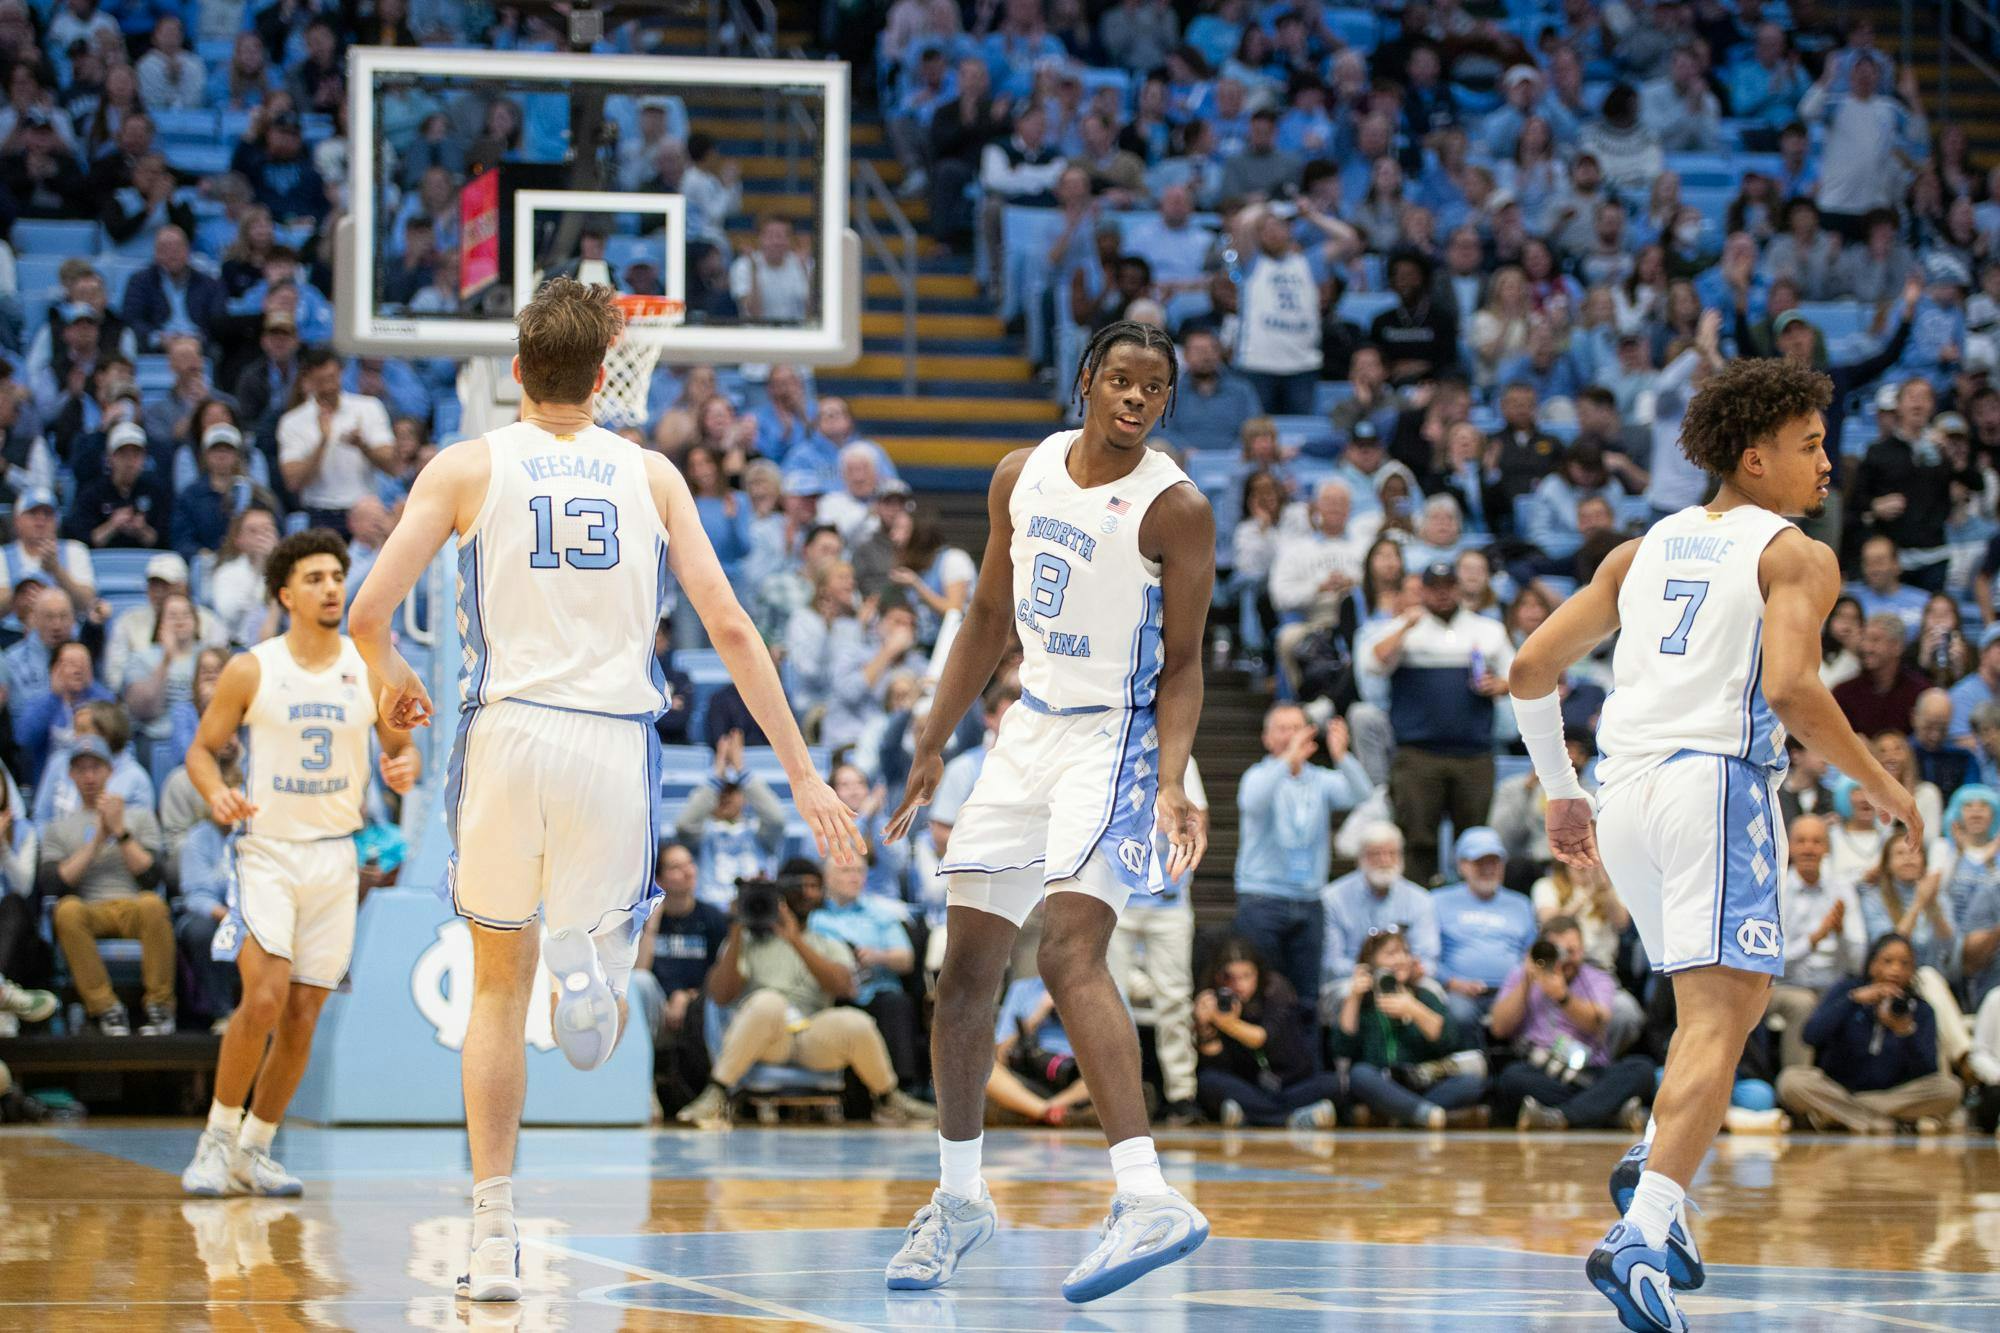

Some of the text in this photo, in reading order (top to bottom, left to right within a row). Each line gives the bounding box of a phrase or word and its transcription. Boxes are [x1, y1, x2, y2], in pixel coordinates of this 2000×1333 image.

[521, 455, 617, 486] VEESAAR
[529, 496, 620, 570] 13
[1027, 515, 1097, 562] NORTH
[1663, 536, 1735, 564] TRIMBLE
[1031, 552, 1072, 619] 8
[1660, 579, 1710, 655] 7
[289, 703, 346, 722] NORTH
[302, 728, 333, 771] 3
